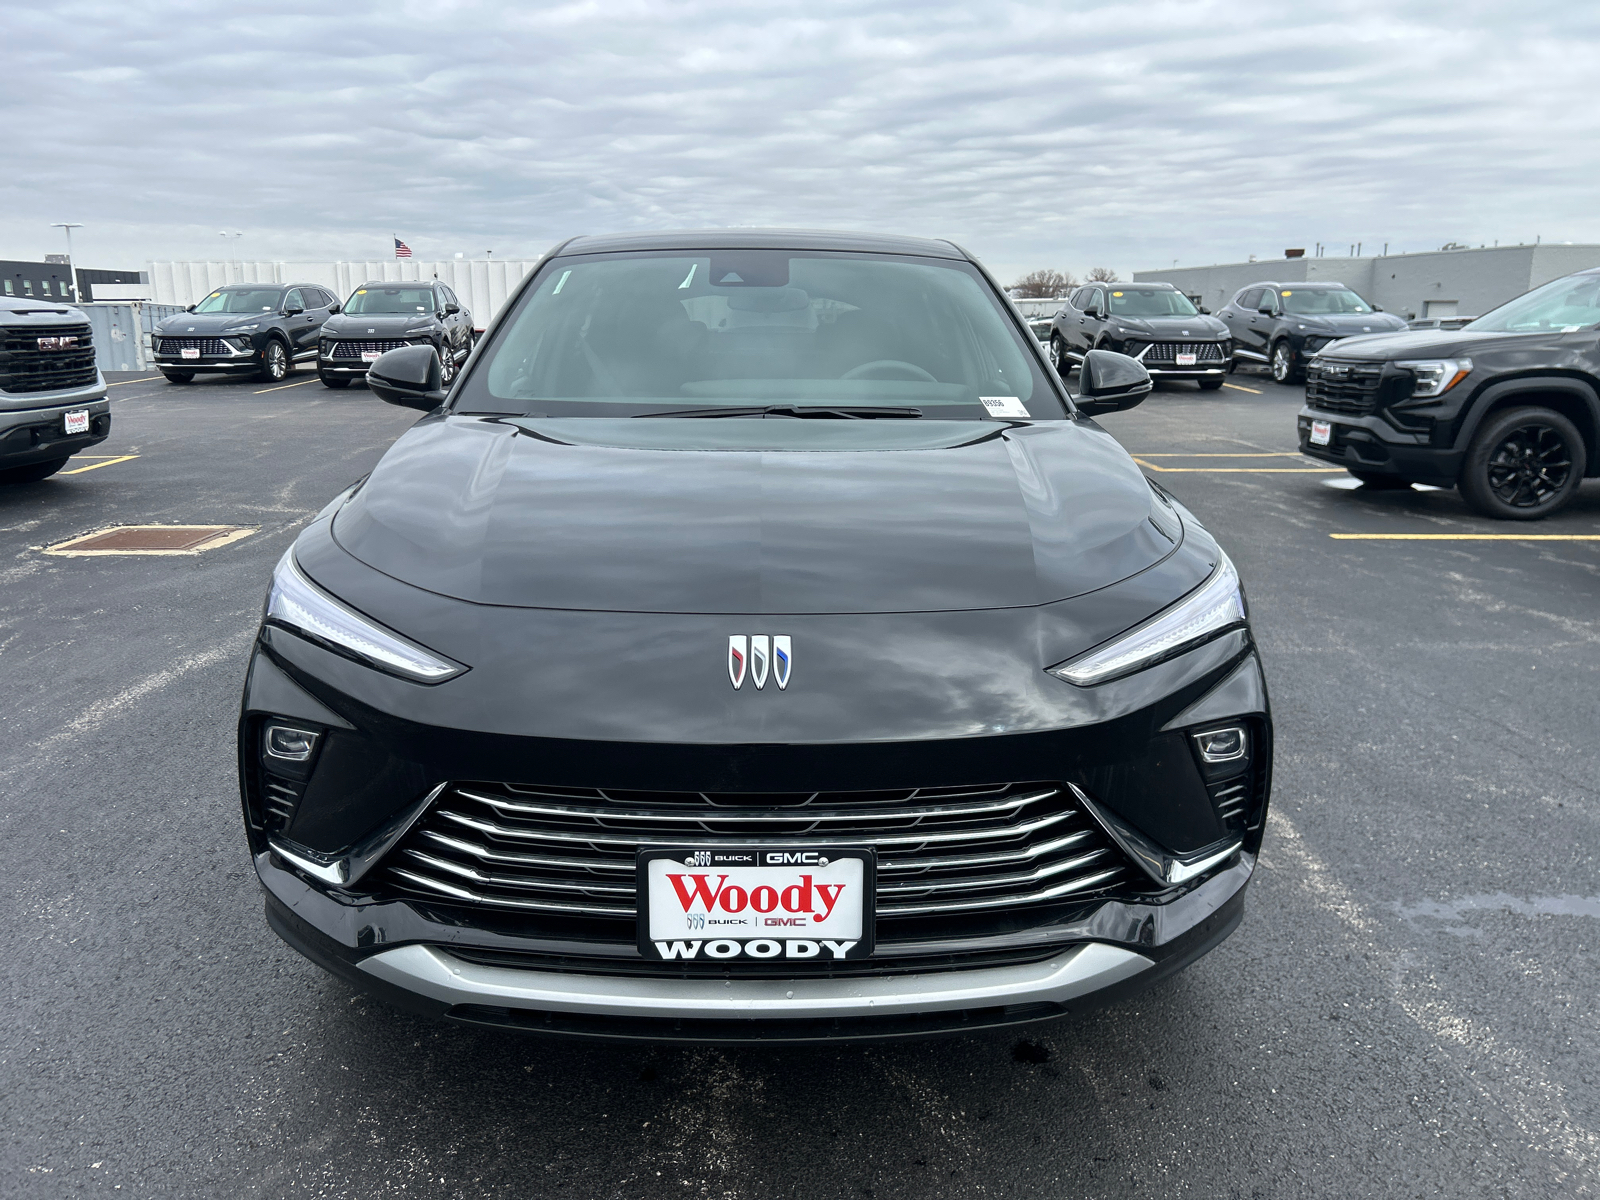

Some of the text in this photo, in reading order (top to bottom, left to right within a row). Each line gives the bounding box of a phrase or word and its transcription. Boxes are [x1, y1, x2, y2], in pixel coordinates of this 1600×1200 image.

[37, 336, 78, 350] GMC
[766, 852, 819, 864] GMC
[665, 874, 846, 923] Woody
[764, 917, 806, 927] GMC
[654, 939, 858, 960] WOODY
